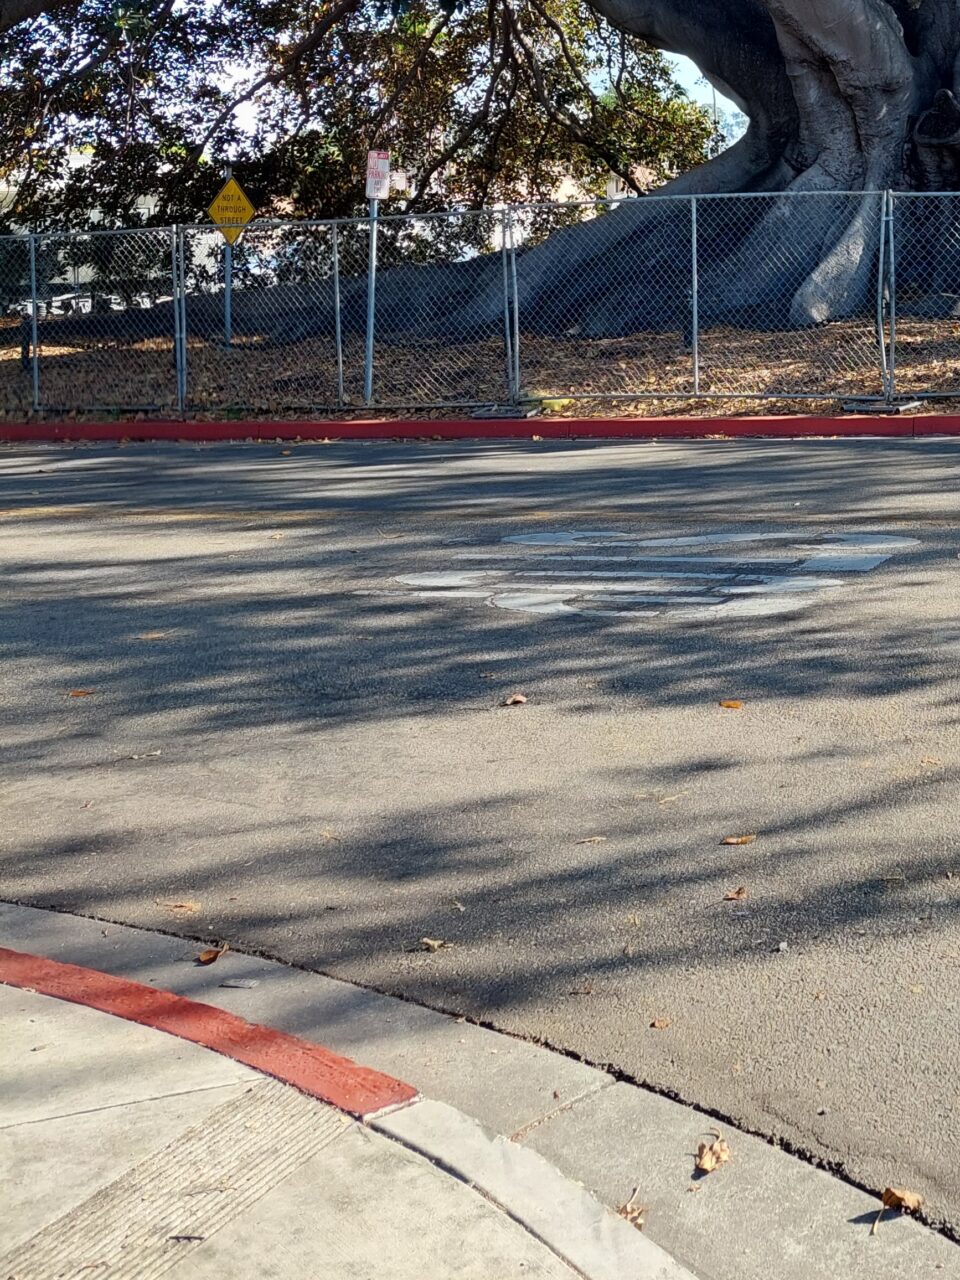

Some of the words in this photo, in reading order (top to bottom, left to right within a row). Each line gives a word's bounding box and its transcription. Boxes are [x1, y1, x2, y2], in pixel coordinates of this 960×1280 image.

[221, 194, 234, 202] NOT
[237, 194, 242, 202] A
[216, 205, 247, 213] THROUGH
[220, 216, 243, 224] STREET
[350, 531, 922, 619] STOP
